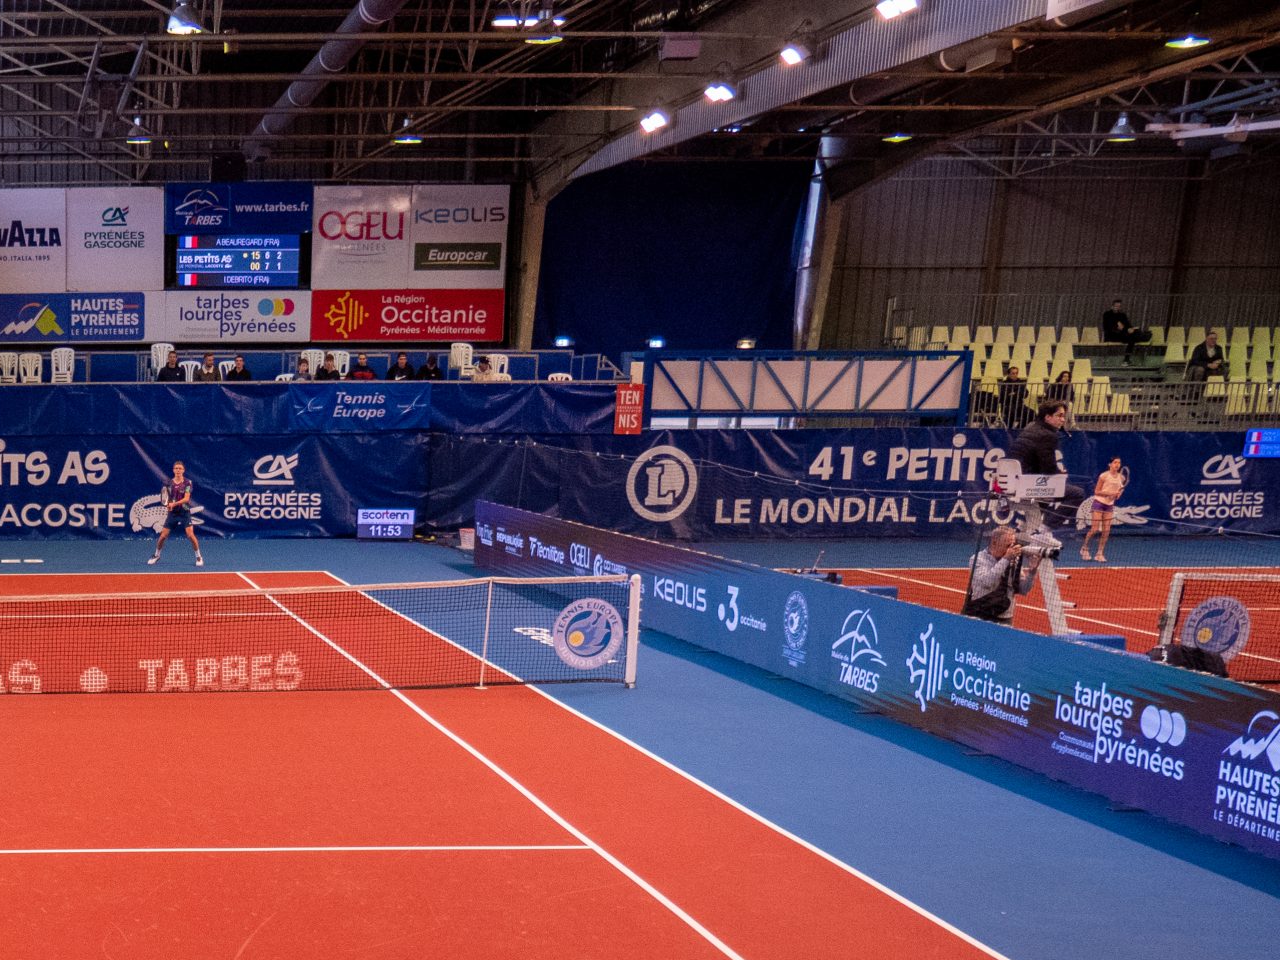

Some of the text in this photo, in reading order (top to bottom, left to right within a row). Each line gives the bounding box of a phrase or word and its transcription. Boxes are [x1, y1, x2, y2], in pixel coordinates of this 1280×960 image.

[235, 202, 309, 213] www.tarbes.fr
[184, 215, 223, 226] TARBES
[318, 211, 405, 240] OGEU
[84, 229, 145, 240] PYRÉNÉES
[84, 240, 145, 249] GASCOGNE
[179, 255, 193, 264] LES
[221, 254, 232, 263] AS
[251, 251, 261, 260] 15
[276, 251, 282, 260] 2
[428, 249, 488, 263] Europcar
[250, 262, 281, 271] 00 7 1
[196, 293, 249, 309] tarbes
[381, 295, 425, 305] La Région
[71, 311, 139, 326] PYRÉNÉES
[180, 306, 242, 321] lourdes
[380, 305, 487, 324] Occitanie
[83, 327, 139, 336] DÉPARTEMENT
[220, 318, 296, 337] pyrénées
[380, 325, 486, 336] Pyrénées Méditerranée
[335, 392, 386, 405] Tennis
[620, 390, 640, 405] TEN
[333, 407, 386, 419] Europe
[618, 414, 638, 428] NIS
[58, 450, 110, 485] AS
[224, 490, 322, 506] PYRÉNÉES
[1171, 489, 1265, 506] PYRÉNÉES
[223, 506, 322, 520] GASCOGNE
[361, 510, 409, 520] scortenn
[714, 496, 917, 525] LE MONDIAL
[1170, 505, 1264, 519] GASCOGNE
[369, 525, 402, 536] 11:53
[570, 542, 591, 569] OGEU
[557, 602, 619, 634] TENNIS EUROPE
[740, 614, 768, 632] occitanie
[561, 646, 594, 667] JUNIOR
[955, 648, 997, 673] La Région
[138, 650, 305, 692] TARBES
[839, 662, 880, 693] TARBES
[952, 667, 1031, 712] Occitanie
[1074, 681, 1133, 719] tarbes
[950, 693, 1029, 728] Pyrénées Méditerranée
[1055, 694, 1123, 738] lourdes
[1094, 734, 1185, 781] pyrénées
[1218, 760, 1280, 797] HAUTES
[1215, 785, 1280, 826] PYRÉNÉ
[1213, 809, 1280, 841] LE DÉPARTEME
